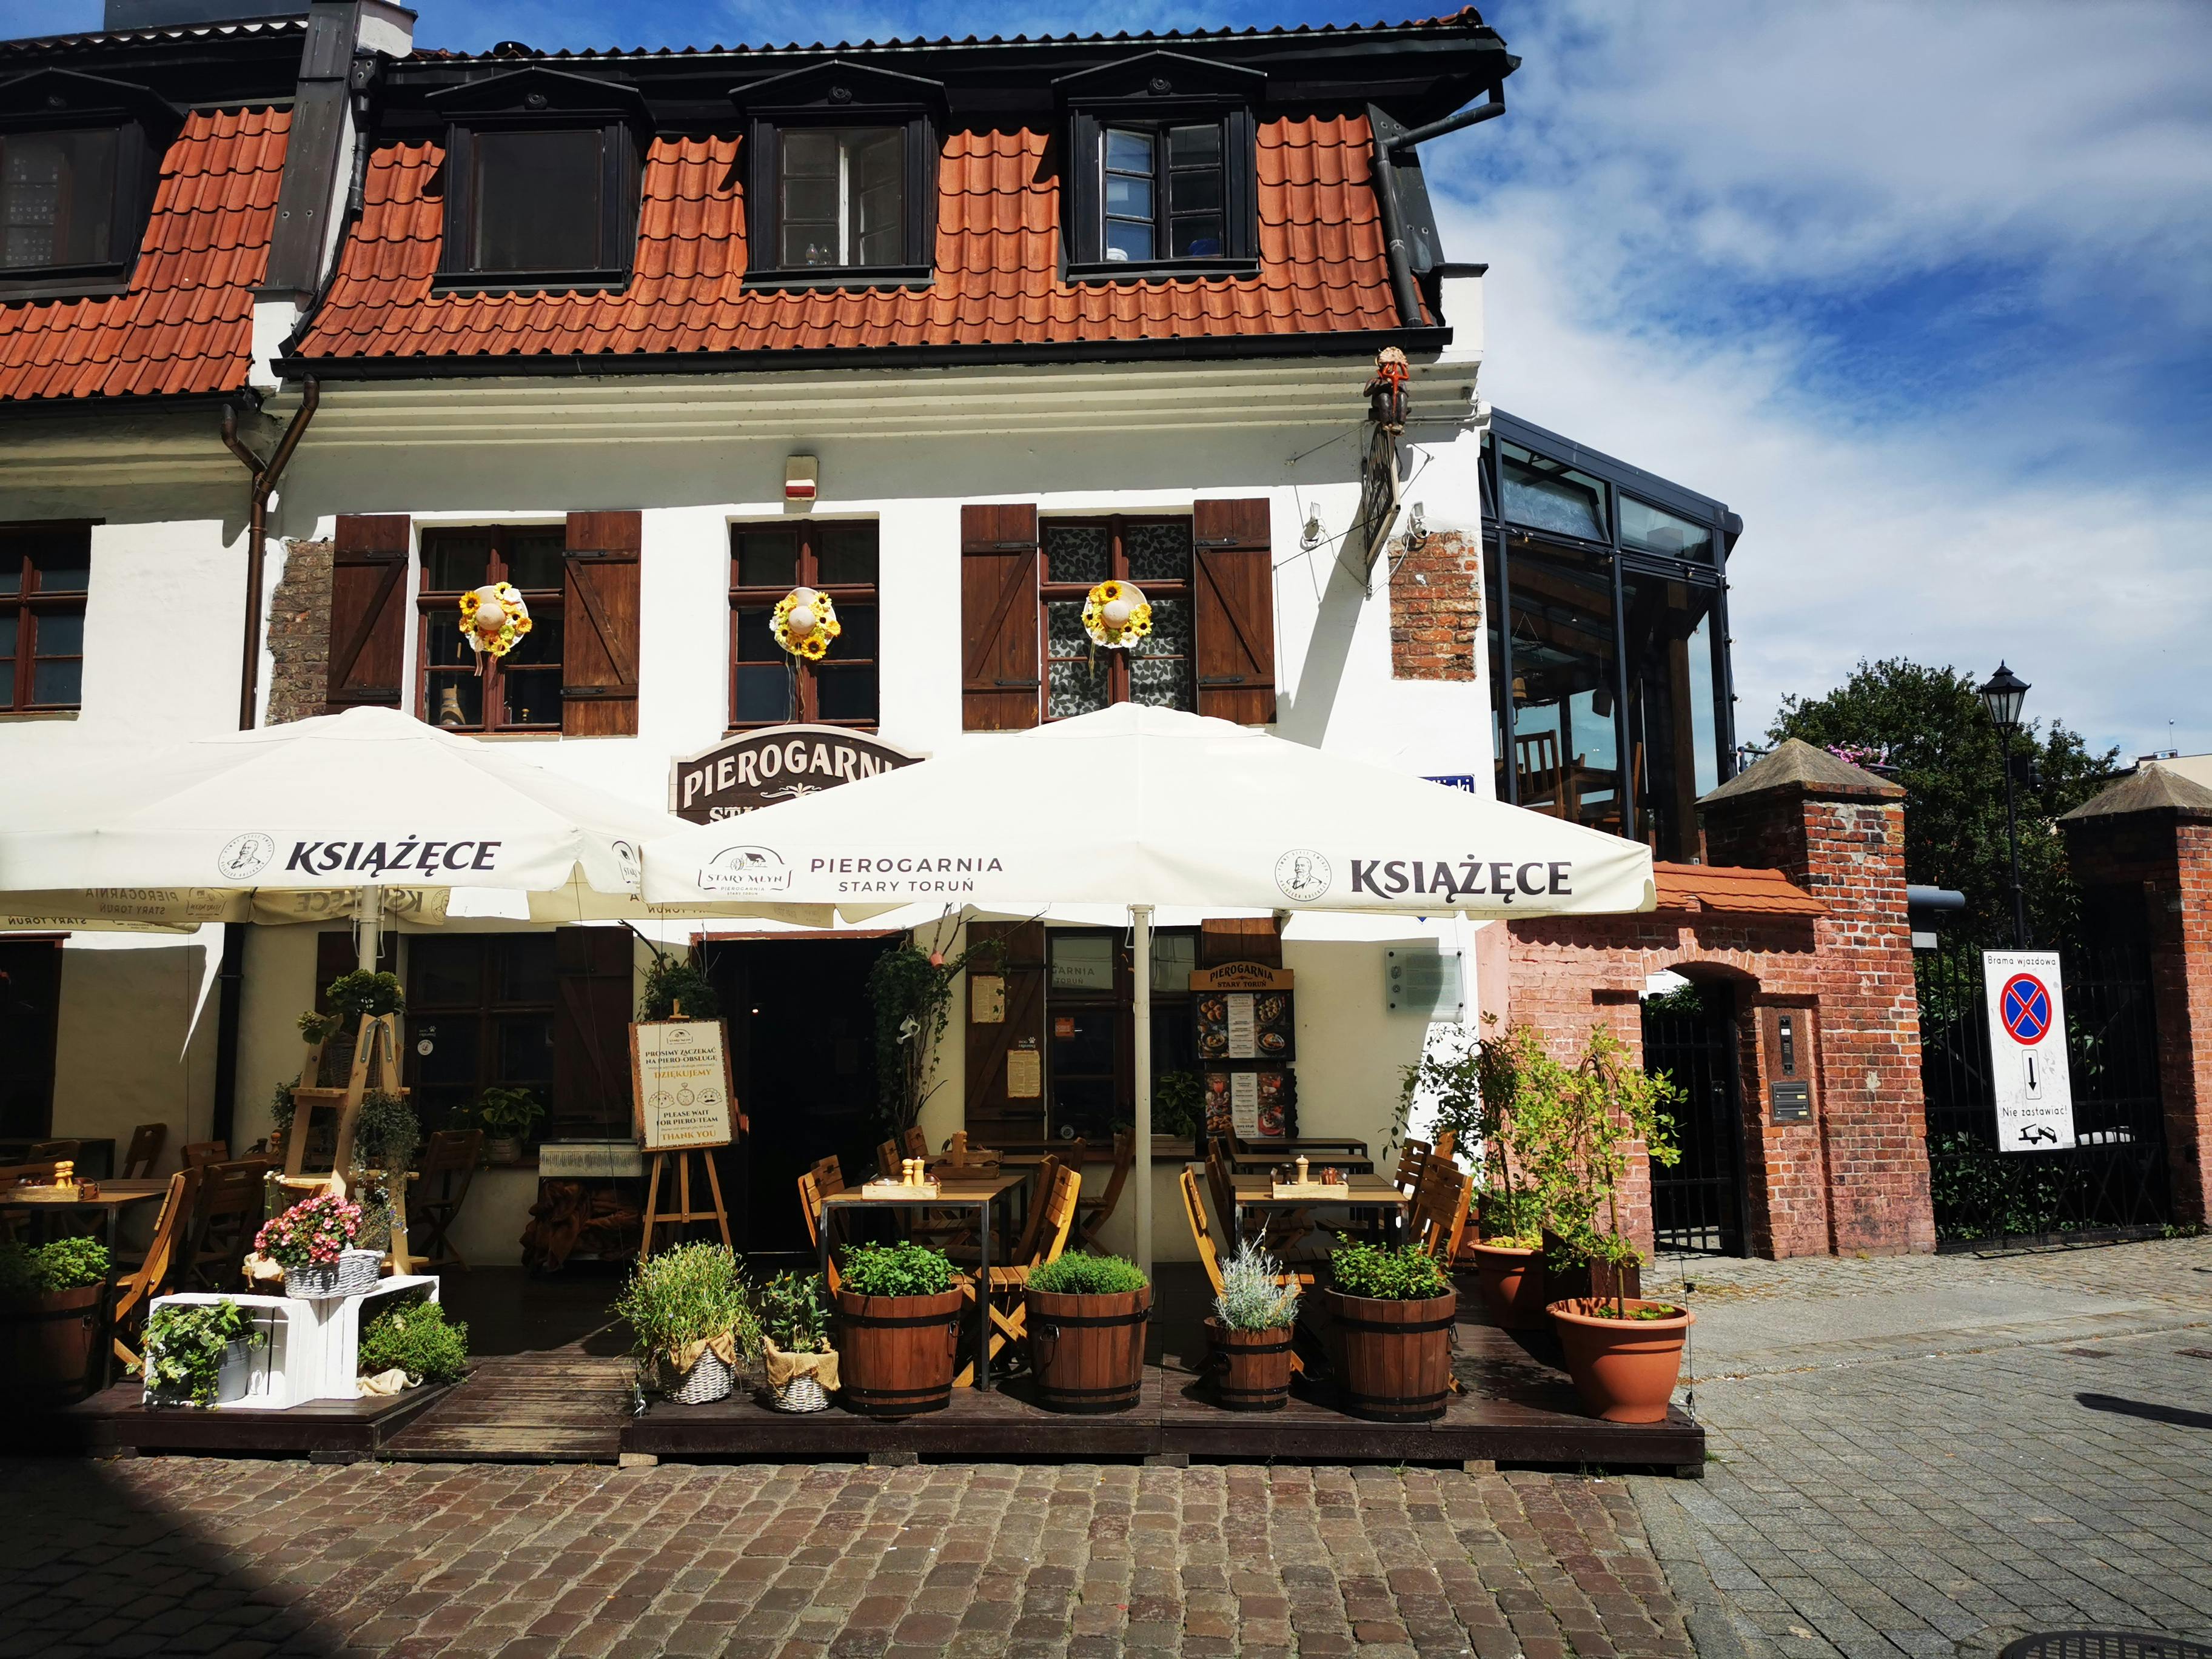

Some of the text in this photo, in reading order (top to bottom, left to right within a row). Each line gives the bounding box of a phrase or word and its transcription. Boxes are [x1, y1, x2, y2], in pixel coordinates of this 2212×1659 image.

[684, 740, 893, 809] PIEROGARN
[285, 834, 501, 877] KSIĄŻĘCE
[811, 858, 1003, 873] PIEROGARNIA
[707, 874, 744, 883] STARY
[839, 878, 973, 891] STARY TORUŃ
[1350, 854, 1572, 903] KSIĄŻĘCE
[1988, 956, 2056, 967] Brama wjazdowa
[1210, 964, 1274, 982] PIEROGARNIA
[654, 1069, 711, 1078] DZIĘKUJEMY
[2003, 1105, 2067, 1116] Nie zastawiać!
